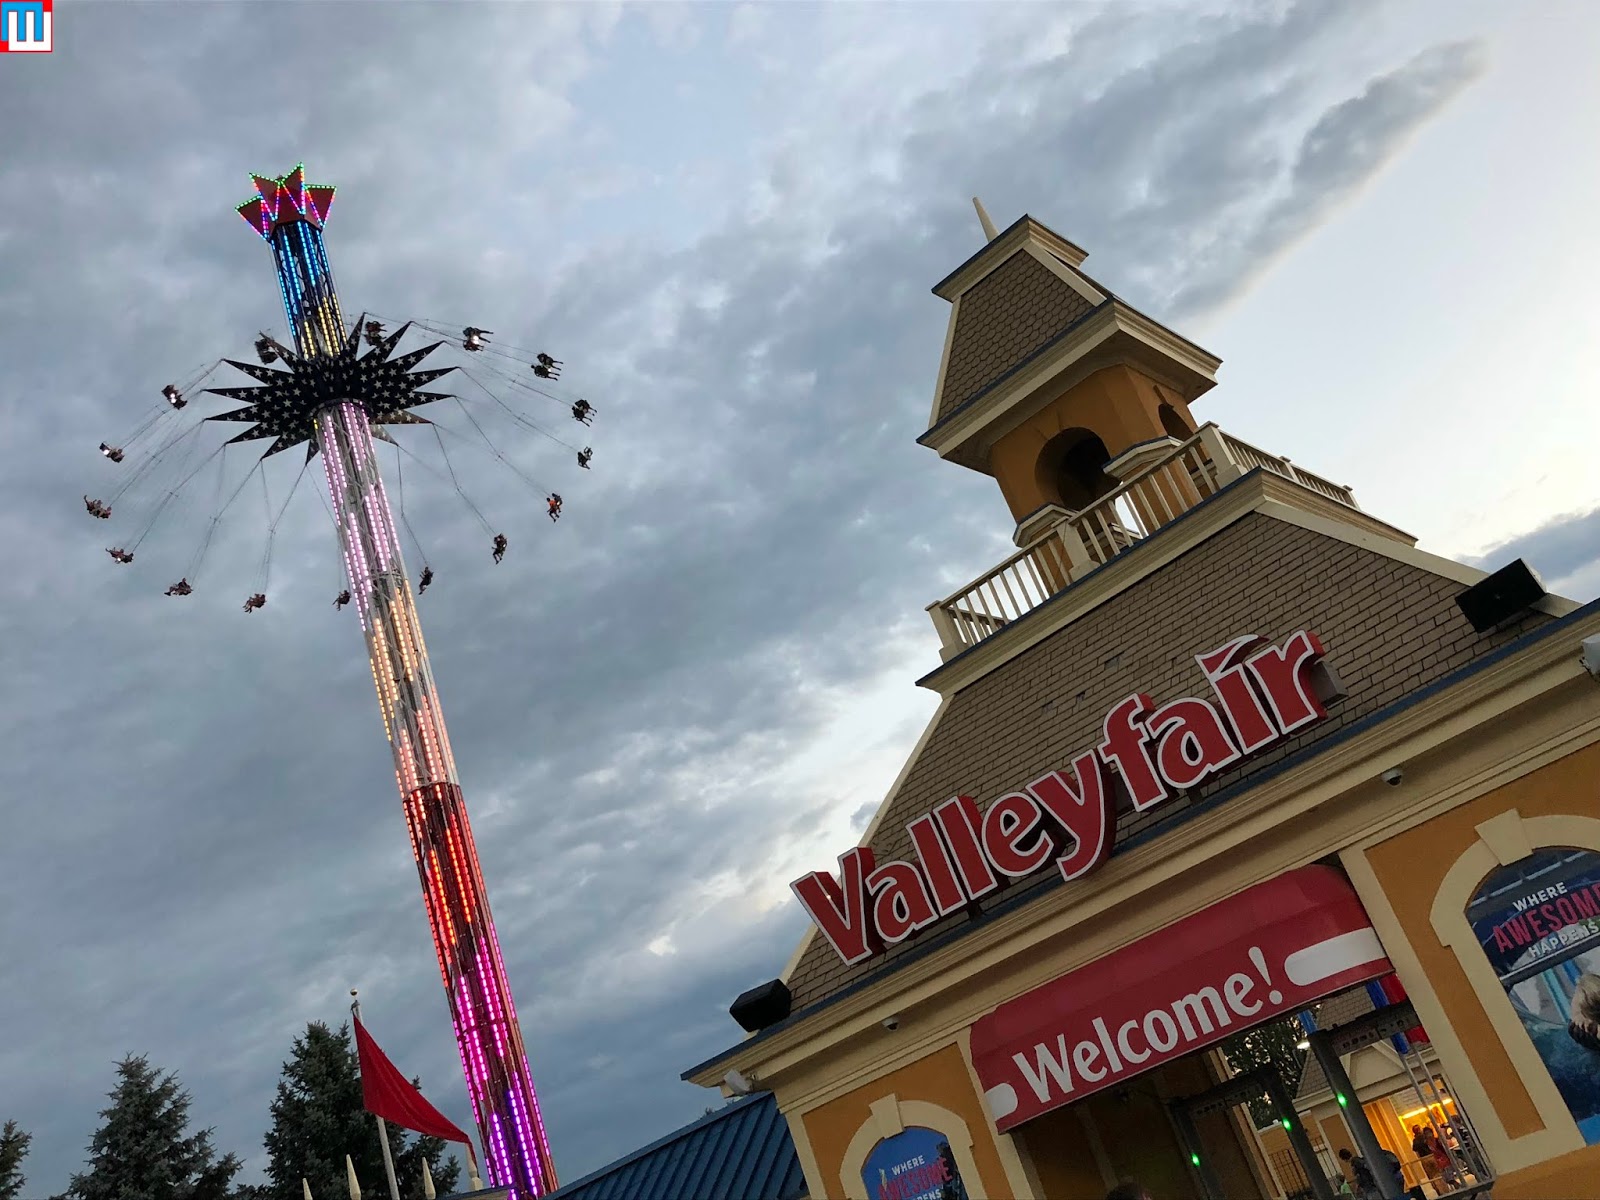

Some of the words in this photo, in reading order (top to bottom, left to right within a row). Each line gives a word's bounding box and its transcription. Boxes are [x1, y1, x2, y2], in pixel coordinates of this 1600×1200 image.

[790, 630, 1325, 966] Valleyfair
[1512, 882, 1568, 911] WHERE
[1528, 918, 1599, 957] HAPPENS
[1012, 946, 1283, 1103] Welcome!
[878, 1157, 953, 1200] AWESOME
[891, 1155, 925, 1175] WHERE
